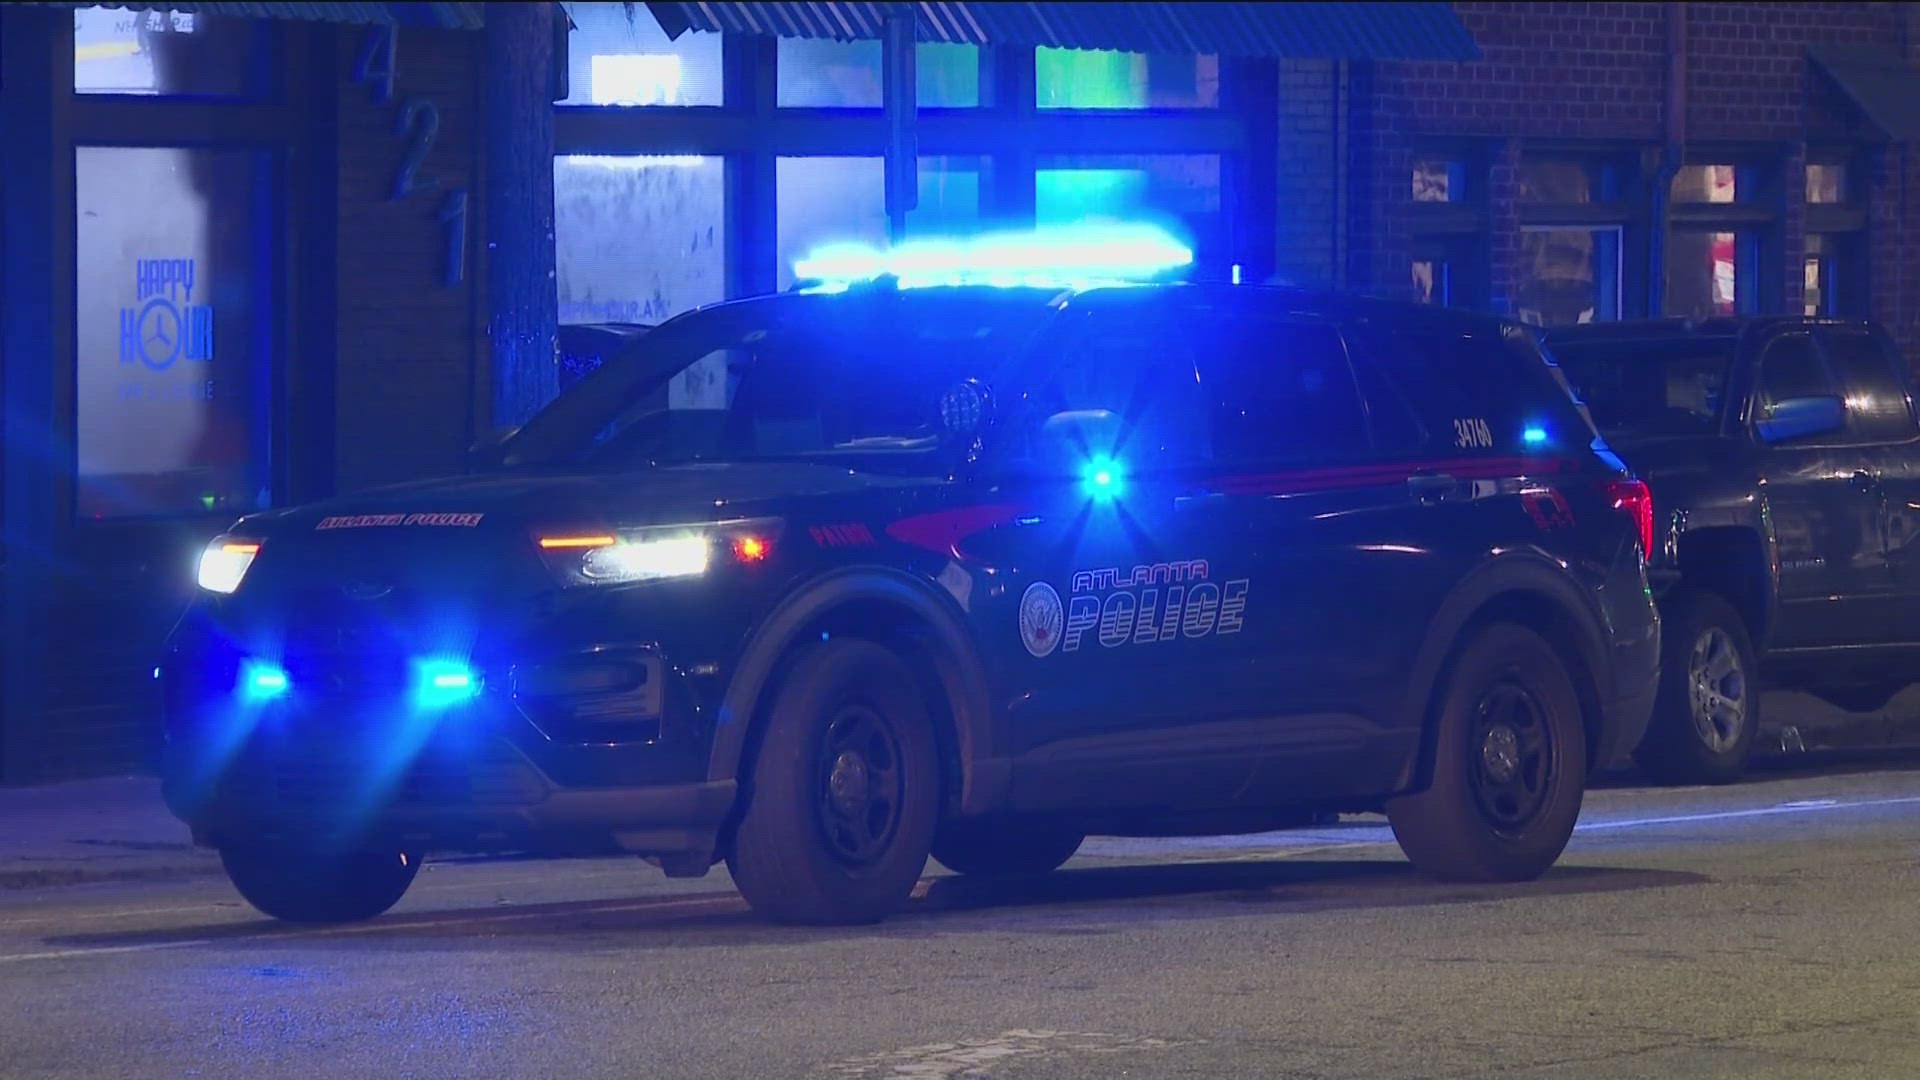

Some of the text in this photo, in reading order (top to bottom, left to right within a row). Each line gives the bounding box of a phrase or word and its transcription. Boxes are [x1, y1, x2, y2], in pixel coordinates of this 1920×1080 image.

[137, 258, 194, 301] HAPPY
[120, 298, 214, 372] HOUR
[1454, 418, 1493, 447] 34760
[315, 512, 484, 530] ATLANTA POLICE
[1072, 559, 1209, 592] ATLANTA
[1063, 579, 1250, 652] POLICE
